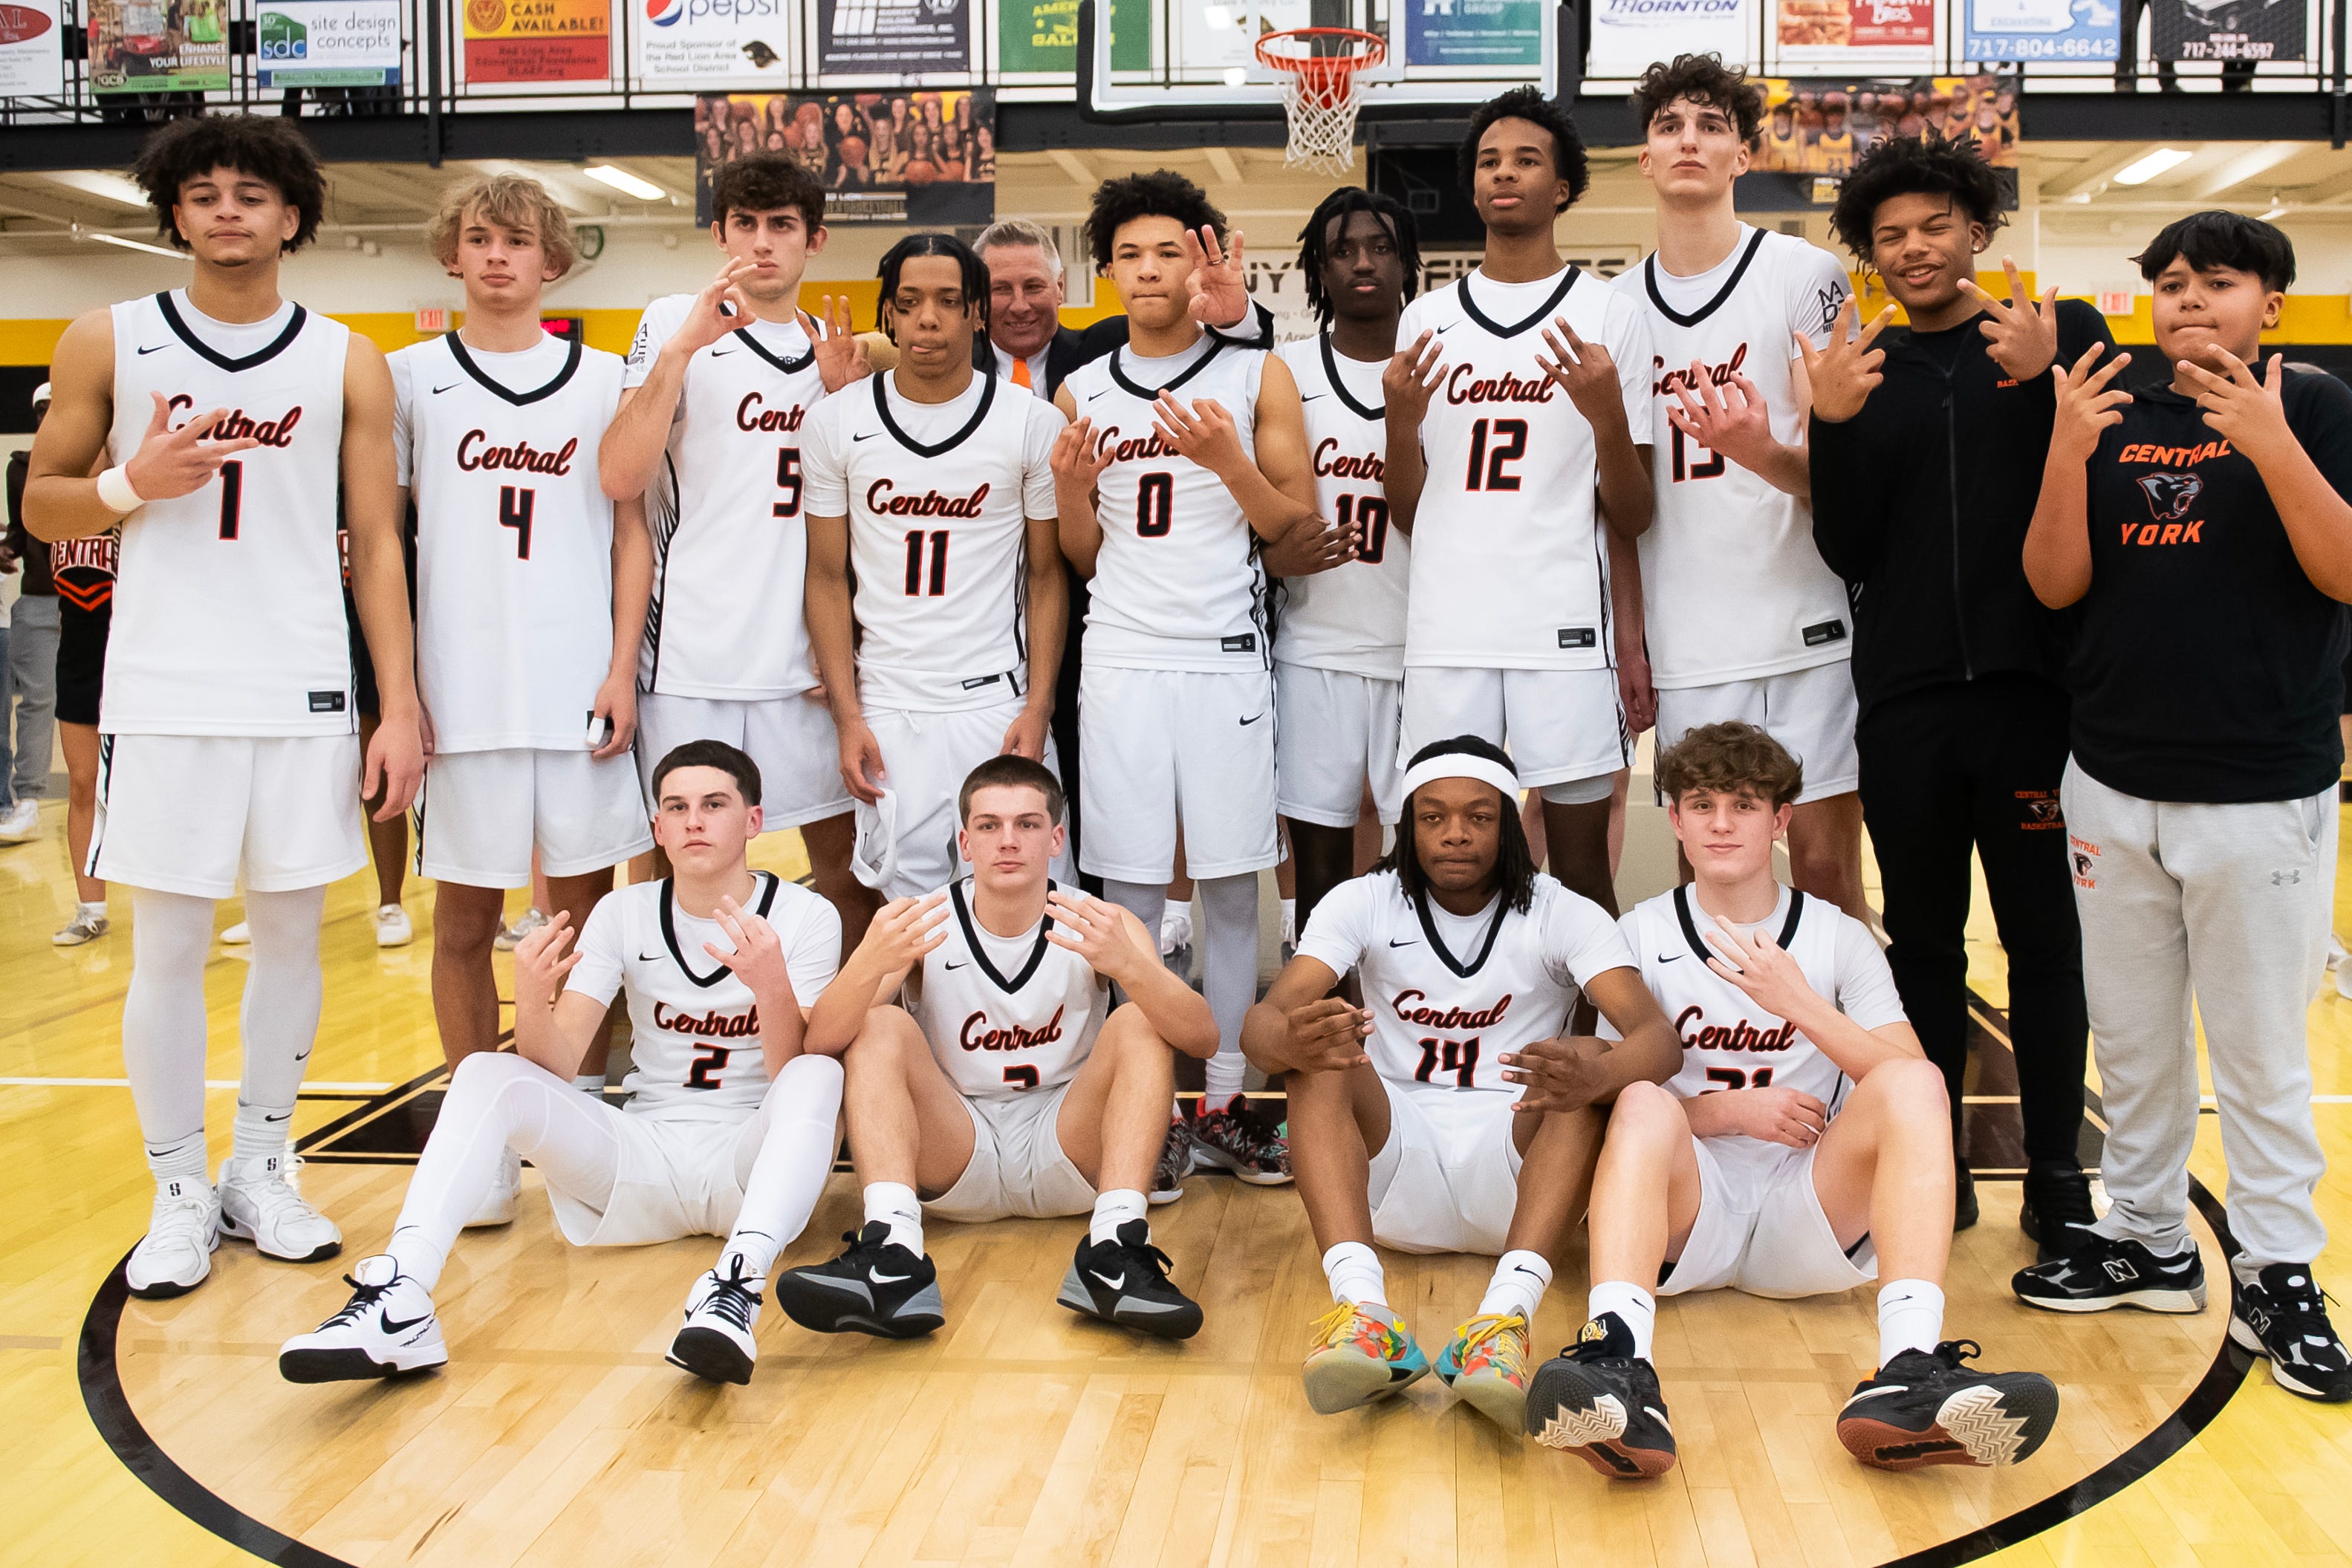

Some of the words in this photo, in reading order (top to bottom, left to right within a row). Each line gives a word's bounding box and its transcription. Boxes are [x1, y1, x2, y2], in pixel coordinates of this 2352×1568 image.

[311, 13, 338, 31] site
[345, 10, 396, 33] design
[510, 2, 555, 16] CASH
[512, 16, 604, 31] AVAILABLE!
[689, 0, 779, 25] pepsi
[178, 43, 227, 54] ENHANCE
[263, 25, 307, 59] sdc
[316, 35, 391, 52] concepts
[646, 42, 677, 50] Proud
[680, 41, 724, 51] Sponsor
[726, 39, 737, 48] of
[646, 52, 663, 62] the
[664, 52, 685, 61] Red
[688, 51, 710, 61] Lion
[712, 51, 737, 60] Area
[1969, 39, 2117, 57] 717-804-6642
[149, 56, 178, 68] YOUR
[180, 54, 227, 67] LIFESTYLE
[654, 64, 689, 73] School
[692, 63, 730, 72] District
[420, 308, 444, 328] EXIT
[1446, 362, 1562, 406] Central
[457, 428, 578, 477] Central
[1465, 417, 1529, 492] 12
[2119, 438, 2231, 468] CENTRAL
[218, 459, 244, 541] 1
[772, 446, 804, 518] 5
[866, 477, 991, 519] Central
[498, 484, 536, 561] 4
[1136, 471, 1175, 538] 0
[1335, 492, 1390, 565] 10
[2121, 520, 2205, 546] YORK
[903, 529, 950, 597] 11
[2015, 790, 2048, 799] CENTRAL
[653, 1000, 761, 1038] Central
[1391, 989, 1513, 1030] Central
[960, 1003, 1065, 1053] Central
[1674, 1004, 1799, 1053] Central
[682, 1041, 731, 1090] 2
[1414, 1035, 1480, 1088] 14
